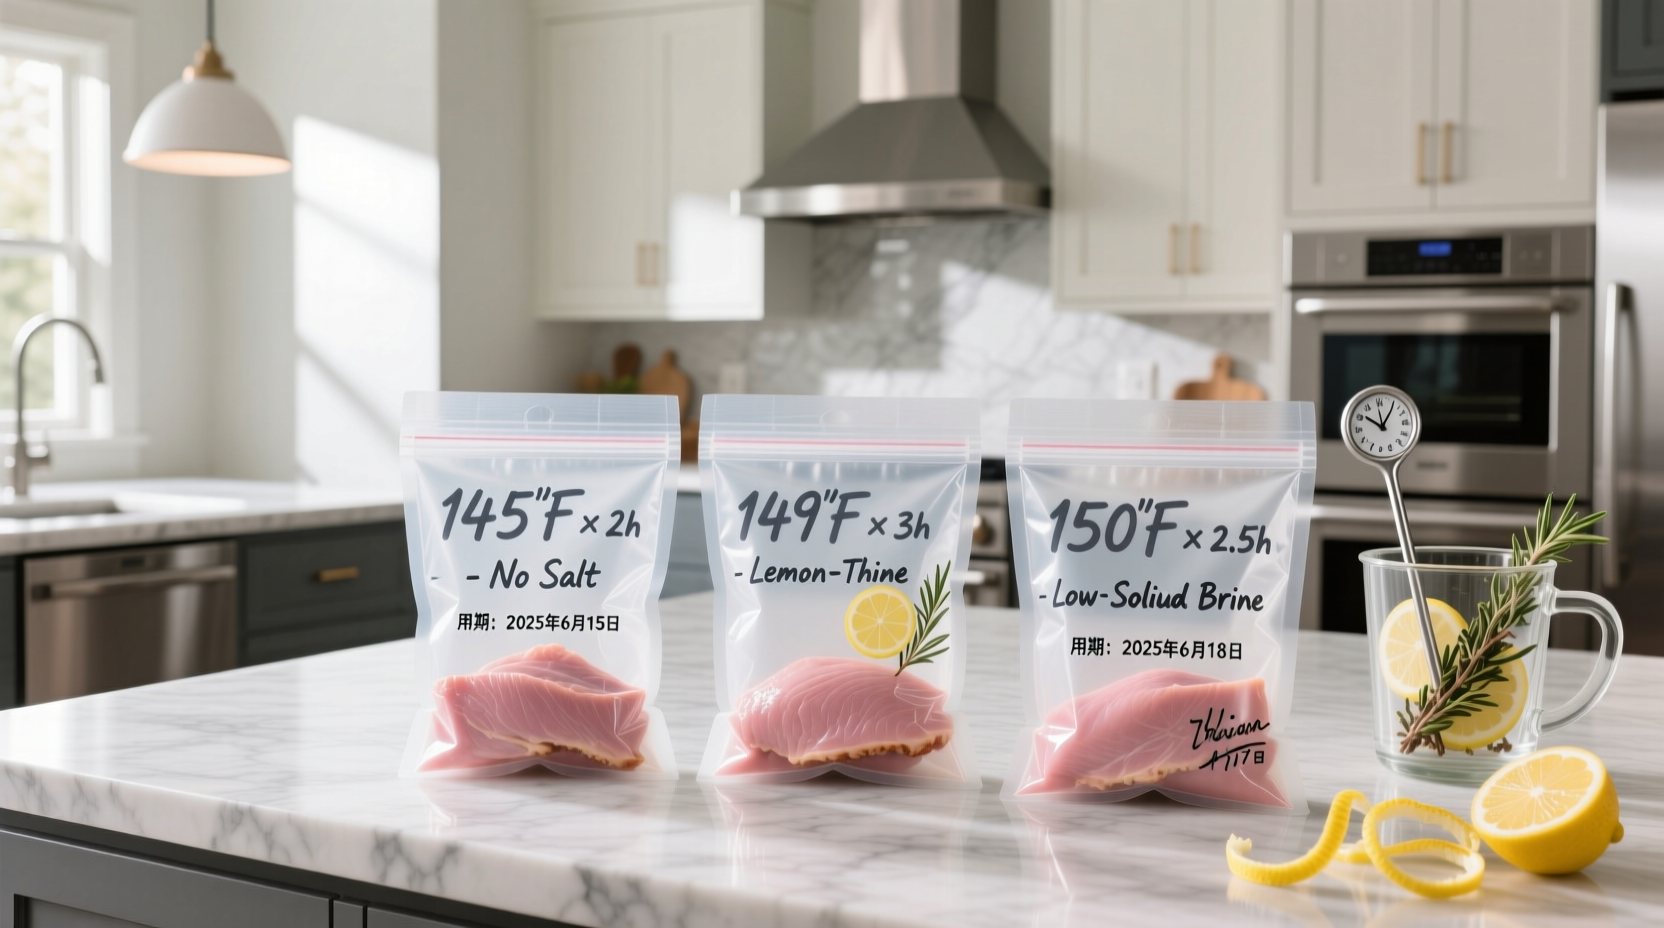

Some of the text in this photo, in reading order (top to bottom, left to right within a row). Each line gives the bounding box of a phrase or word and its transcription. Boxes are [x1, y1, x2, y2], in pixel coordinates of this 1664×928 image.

[605, 509, 641, 538] 2h
[893, 511, 930, 540] 3h
[1210, 524, 1272, 555] 2.5h
[489, 558, 530, 589] No
[539, 558, 601, 589] Salt
[1198, 581, 1264, 612] Brine
